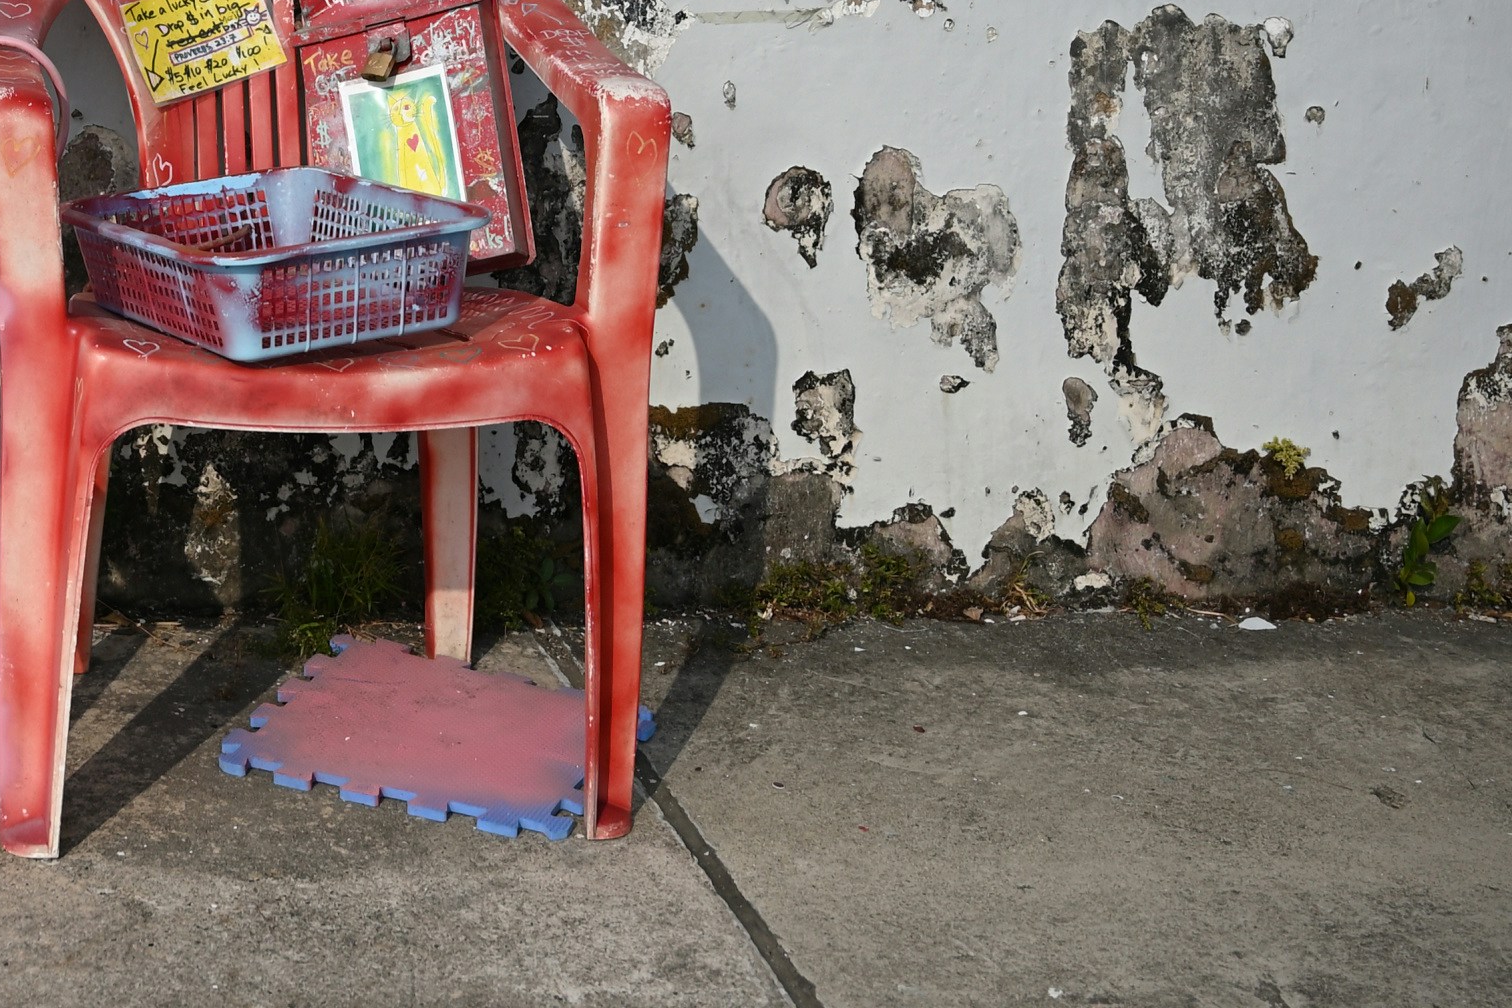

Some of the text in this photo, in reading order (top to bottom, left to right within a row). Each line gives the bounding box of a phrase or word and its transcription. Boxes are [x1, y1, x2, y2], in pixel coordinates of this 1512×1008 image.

[125, 2, 157, 23] Take
[159, 7, 166, 15] a
[155, 20, 184, 37] Drop
[200, 7, 214, 19] in
[215, 0, 250, 18] big
[174, 44, 214, 63] PROVERBS
[304, 49, 354, 76] Take
[204, 58, 228, 73] $20
[179, 76, 208, 94] Feel
